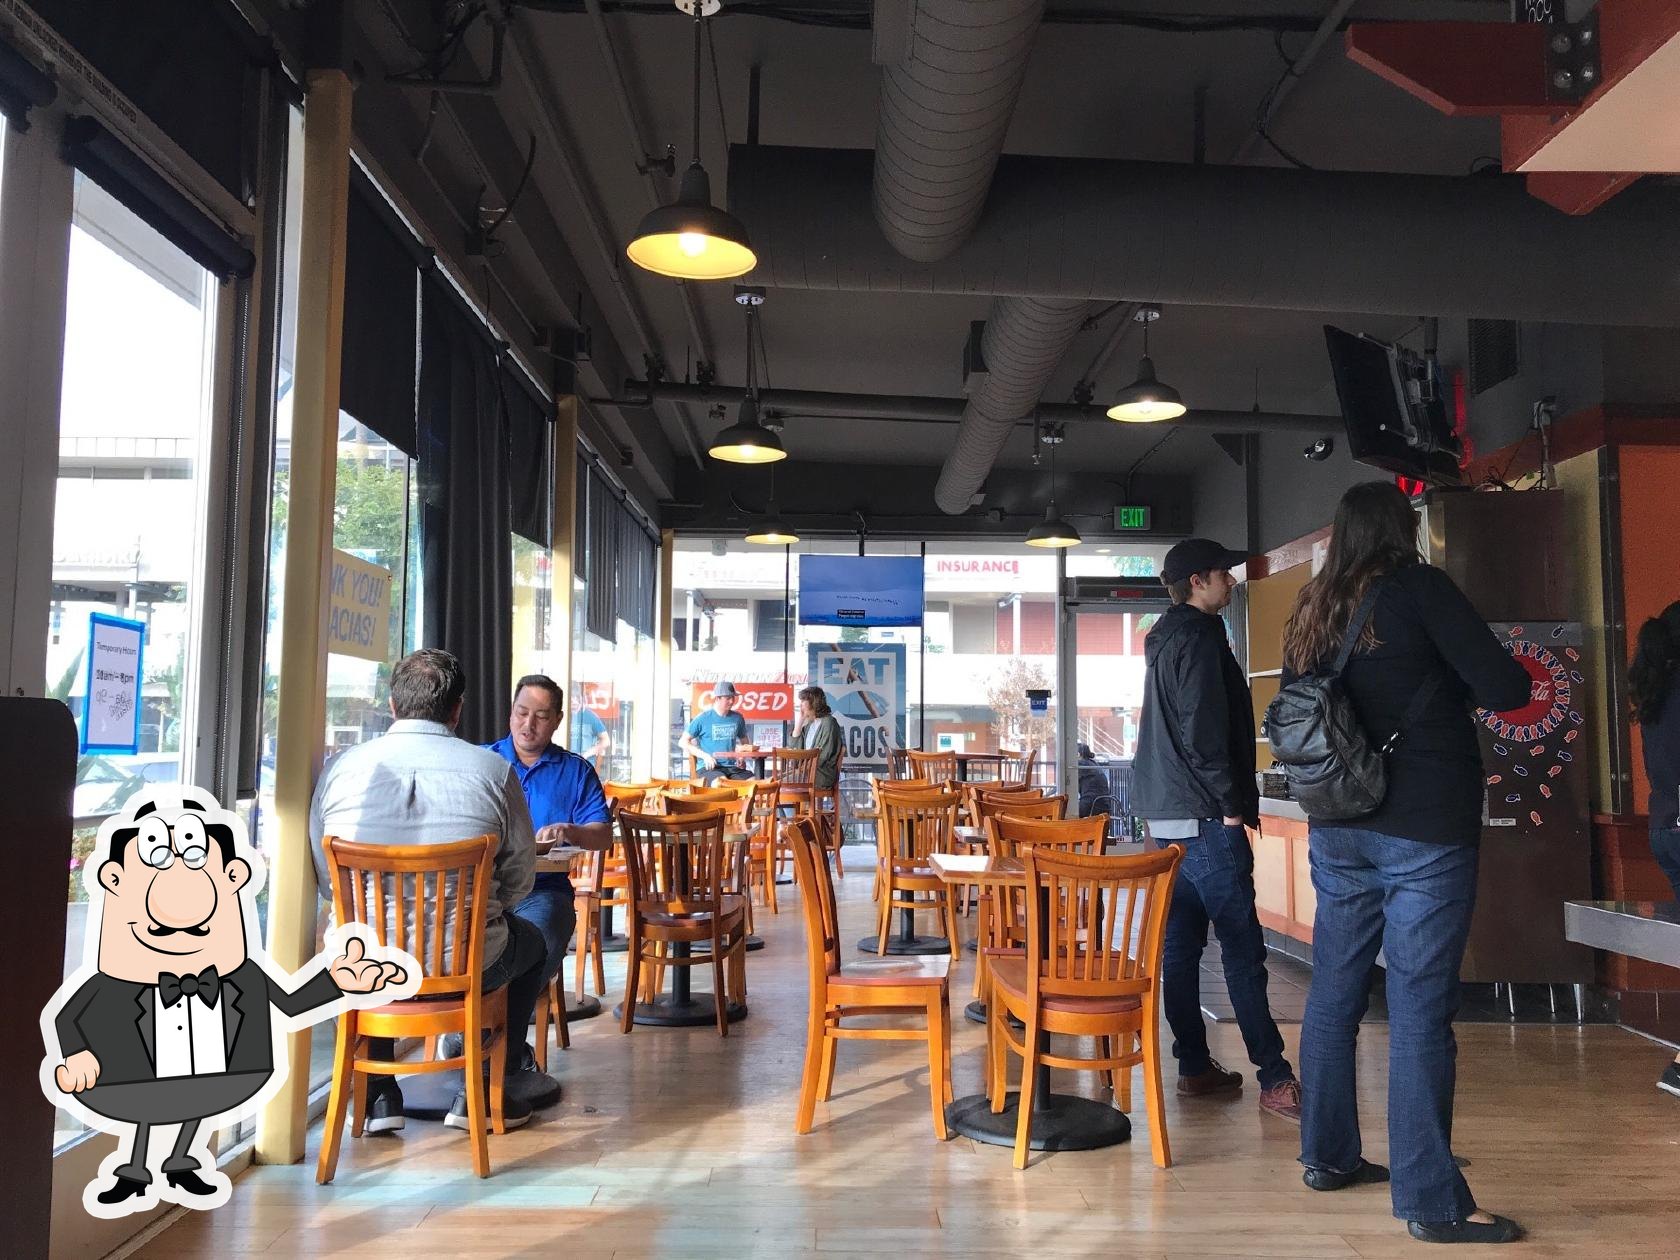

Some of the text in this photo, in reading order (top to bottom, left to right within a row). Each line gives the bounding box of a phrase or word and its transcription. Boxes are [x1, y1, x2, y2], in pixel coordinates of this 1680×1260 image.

[1121, 508, 1145, 527] EXIT
[352, 570, 384, 608] YOU!
[823, 657, 891, 685] EAT
